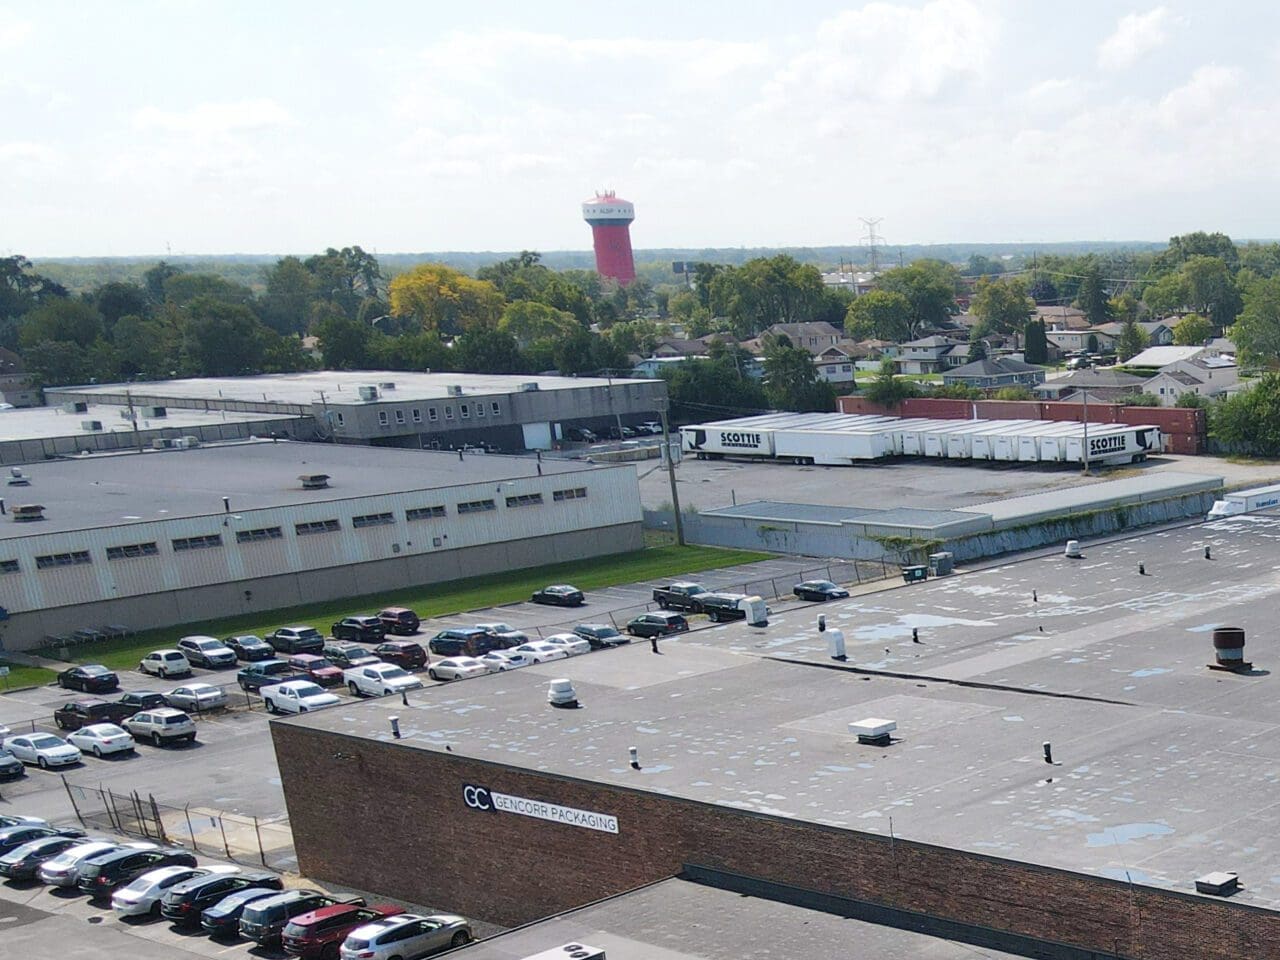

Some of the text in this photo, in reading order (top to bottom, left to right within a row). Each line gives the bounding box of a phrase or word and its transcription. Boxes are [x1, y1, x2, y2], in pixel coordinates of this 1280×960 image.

[721, 432, 761, 444] SCOTTIE
[1090, 435, 1126, 450] SCOTTIE
[464, 785, 490, 810] GC
[496, 796, 616, 831] GENCORR PACKAGING
